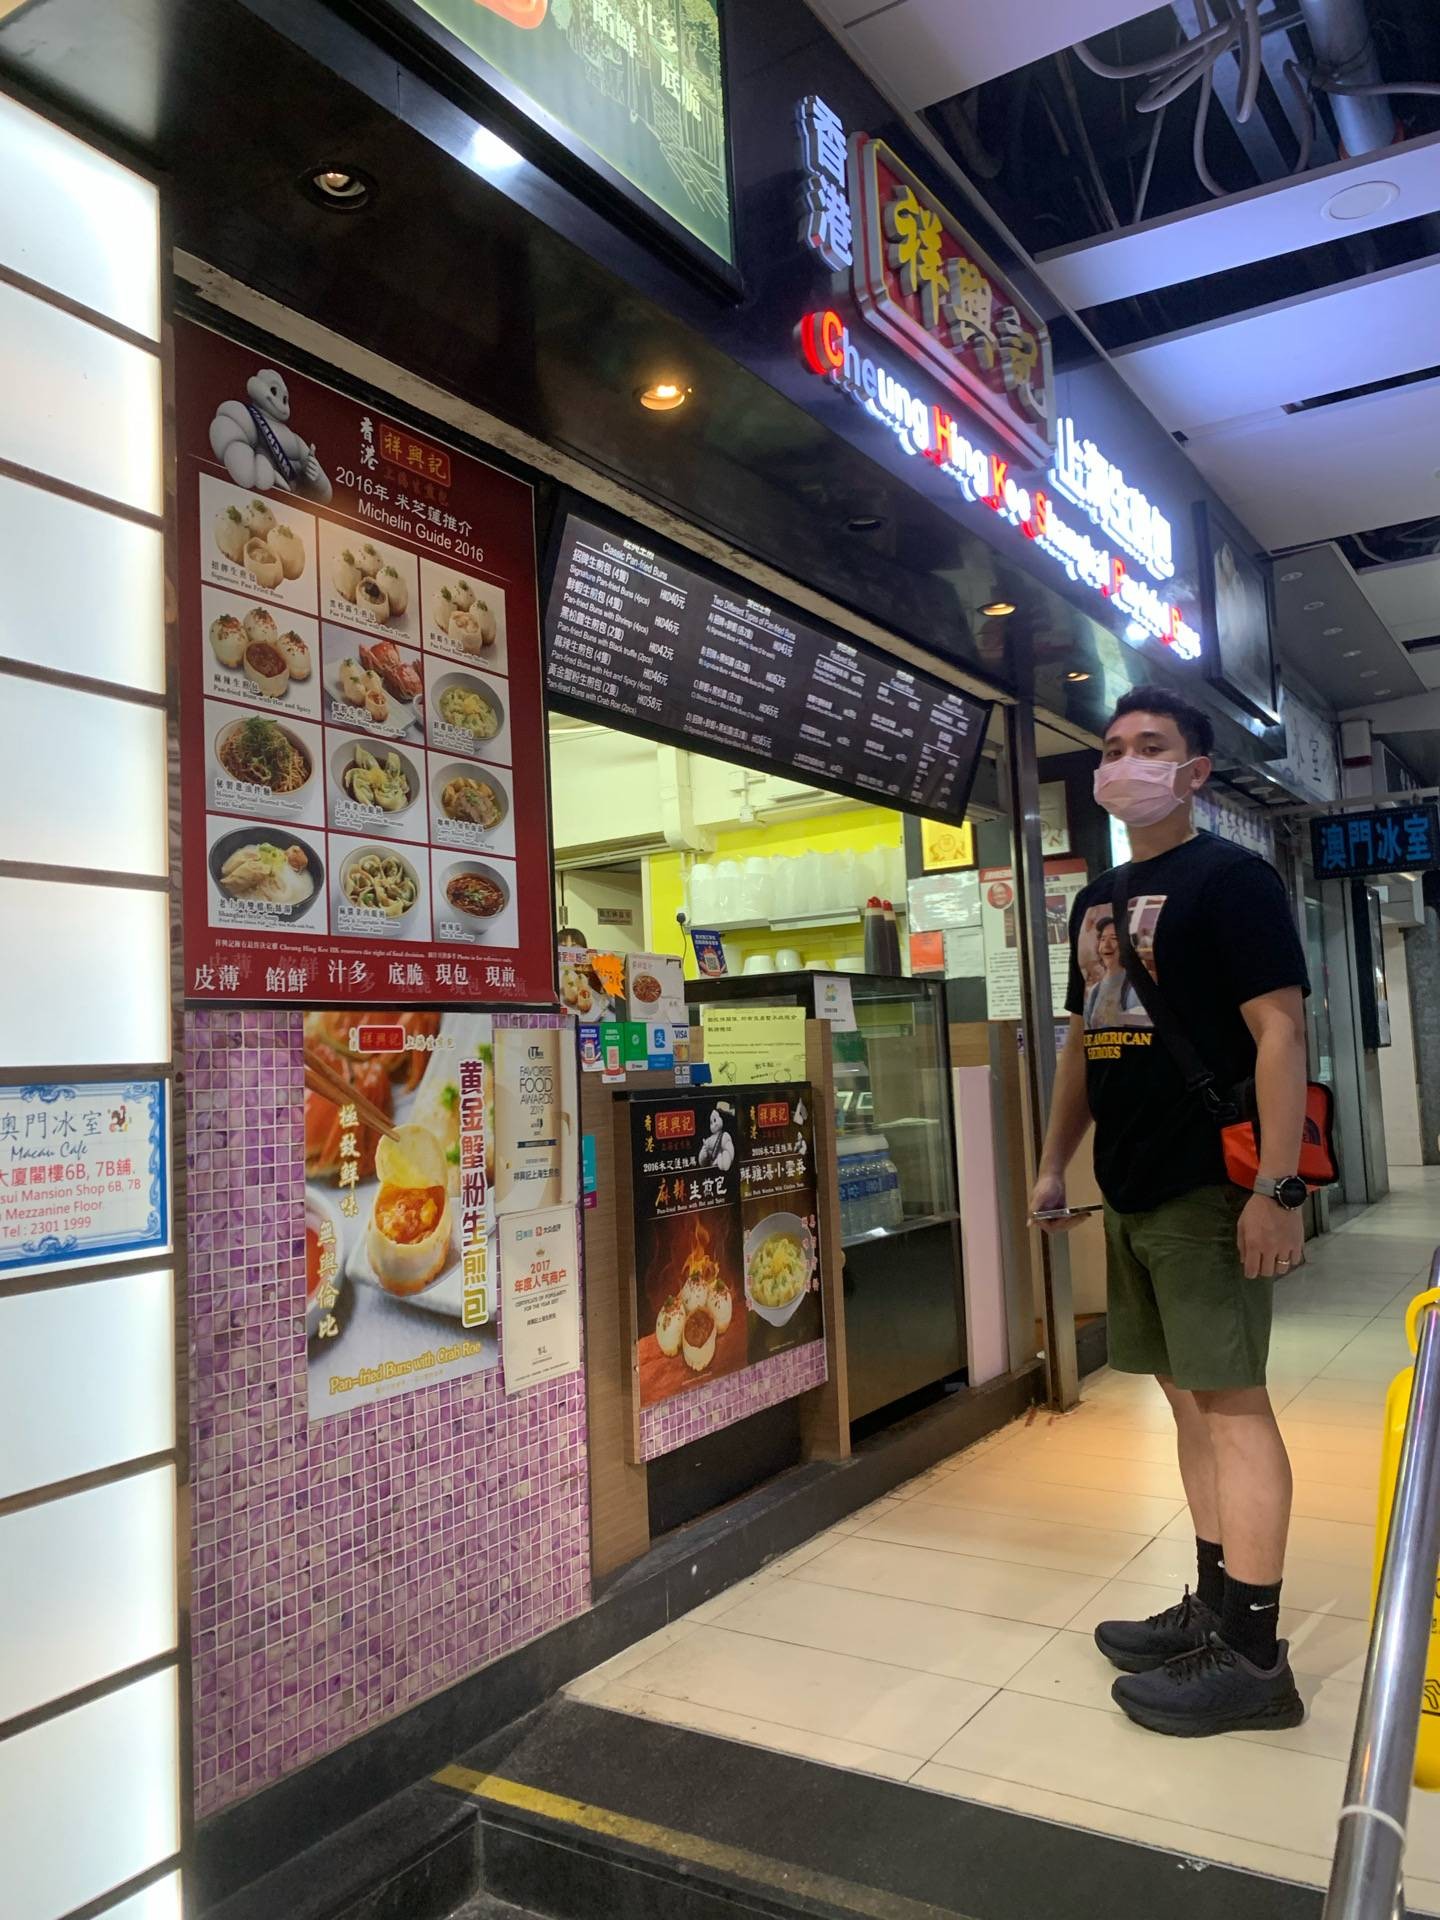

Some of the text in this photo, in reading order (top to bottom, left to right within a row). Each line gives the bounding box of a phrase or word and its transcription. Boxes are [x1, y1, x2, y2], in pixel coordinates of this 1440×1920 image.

[797, 95, 853, 272] 香港
[882, 184, 1050, 420] 祥興記
[815, 310, 930, 450] Cheung
[932, 404, 989, 499] Hing
[990, 454, 1031, 522] Kee
[361, 417, 379, 470] 香港
[383, 431, 448, 480] 祥興記
[336, 466, 473, 538] 2016年 米芝蓮推介
[358, 498, 484, 563] Michelin Guide 2016
[602, 542, 668, 580] Classic Pan-fried Buns
[569, 562, 596, 583] Signature
[620, 586, 633, 598] Buns
[572, 548, 611, 576] 招牌生煎包
[659, 588, 685, 609] HKD40元
[565, 575, 605, 605] 鮮蝦生煎包
[654, 615, 679, 635] HKD46元
[589, 603, 602, 615] Buns
[603, 610, 614, 620] with
[614, 613, 632, 628] Shrimp
[559, 604, 606, 636] 黑松露生煎包
[648, 640, 674, 661] HKD42元
[583, 630, 596, 644] Buns
[608, 640, 623, 653] Black
[553, 631, 593, 661] 麻辣生煎包
[643, 666, 668, 687] HKD46元
[577, 658, 591, 672] Buns
[591, 664, 602, 675] with
[602, 667, 614, 679] Hot
[614, 672, 623, 681] and
[623, 675, 637, 688] Spicy
[571, 685, 584, 699] Buns
[596, 693, 610, 706] Crab
[637, 690, 662, 713] HKD58元
[1321, 813, 1432, 870] 澳門冰室
[193, 959, 517, 993] 皮薄 餡鮮 汁多 底脆 現包 現煎
[674, 1030, 688, 1039] VISA
[1093, 1031, 1153, 1046] AMERICAN
[519, 1065, 553, 1077] FAVORITE
[519, 1077, 553, 1093] FOOD
[520, 1093, 554, 1105] AWARDS
[657, 1116, 693, 1136] 祥興記
[11, 1140, 88, 1162] Macau Cafe
[21, 1187, 73, 1201] Mansion
[76, 1183, 105, 1197] Shop
[128, 1178, 141, 1190] 7B
[5, 1200, 103, 1220] Mezzanine Floor
[3, 1225, 21, 1238] Tel
[31, 1220, 59, 1235] 2301
[63, 1216, 92, 1231] 1999
[317, 1221, 340, 1339] 無與倫比
[514, 1268, 567, 1293] 年度人气商户
[530, 1260, 550, 1274] 2017
[329, 1364, 383, 1394] Pan-fried
[386, 1358, 412, 1378] Buns
[413, 1352, 435, 1370] with
[437, 1346, 460, 1364] Crab
[462, 1340, 482, 1357] Roe
